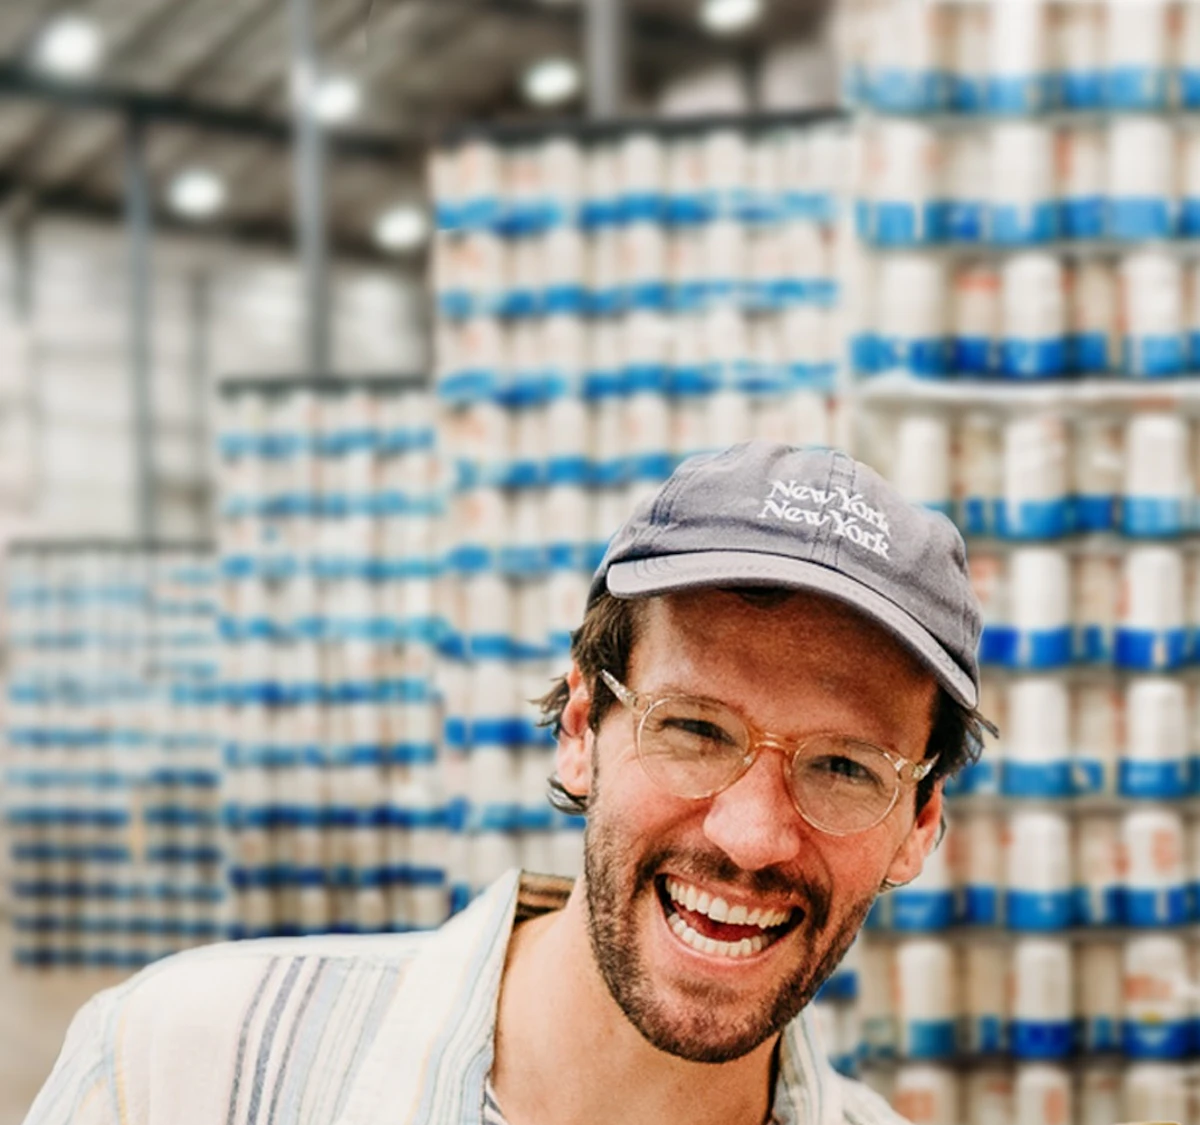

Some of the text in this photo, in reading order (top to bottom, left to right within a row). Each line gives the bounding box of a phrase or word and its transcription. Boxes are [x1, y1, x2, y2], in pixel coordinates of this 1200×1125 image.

[756, 500, 890, 560] New York
[768, 479, 892, 538] New York
